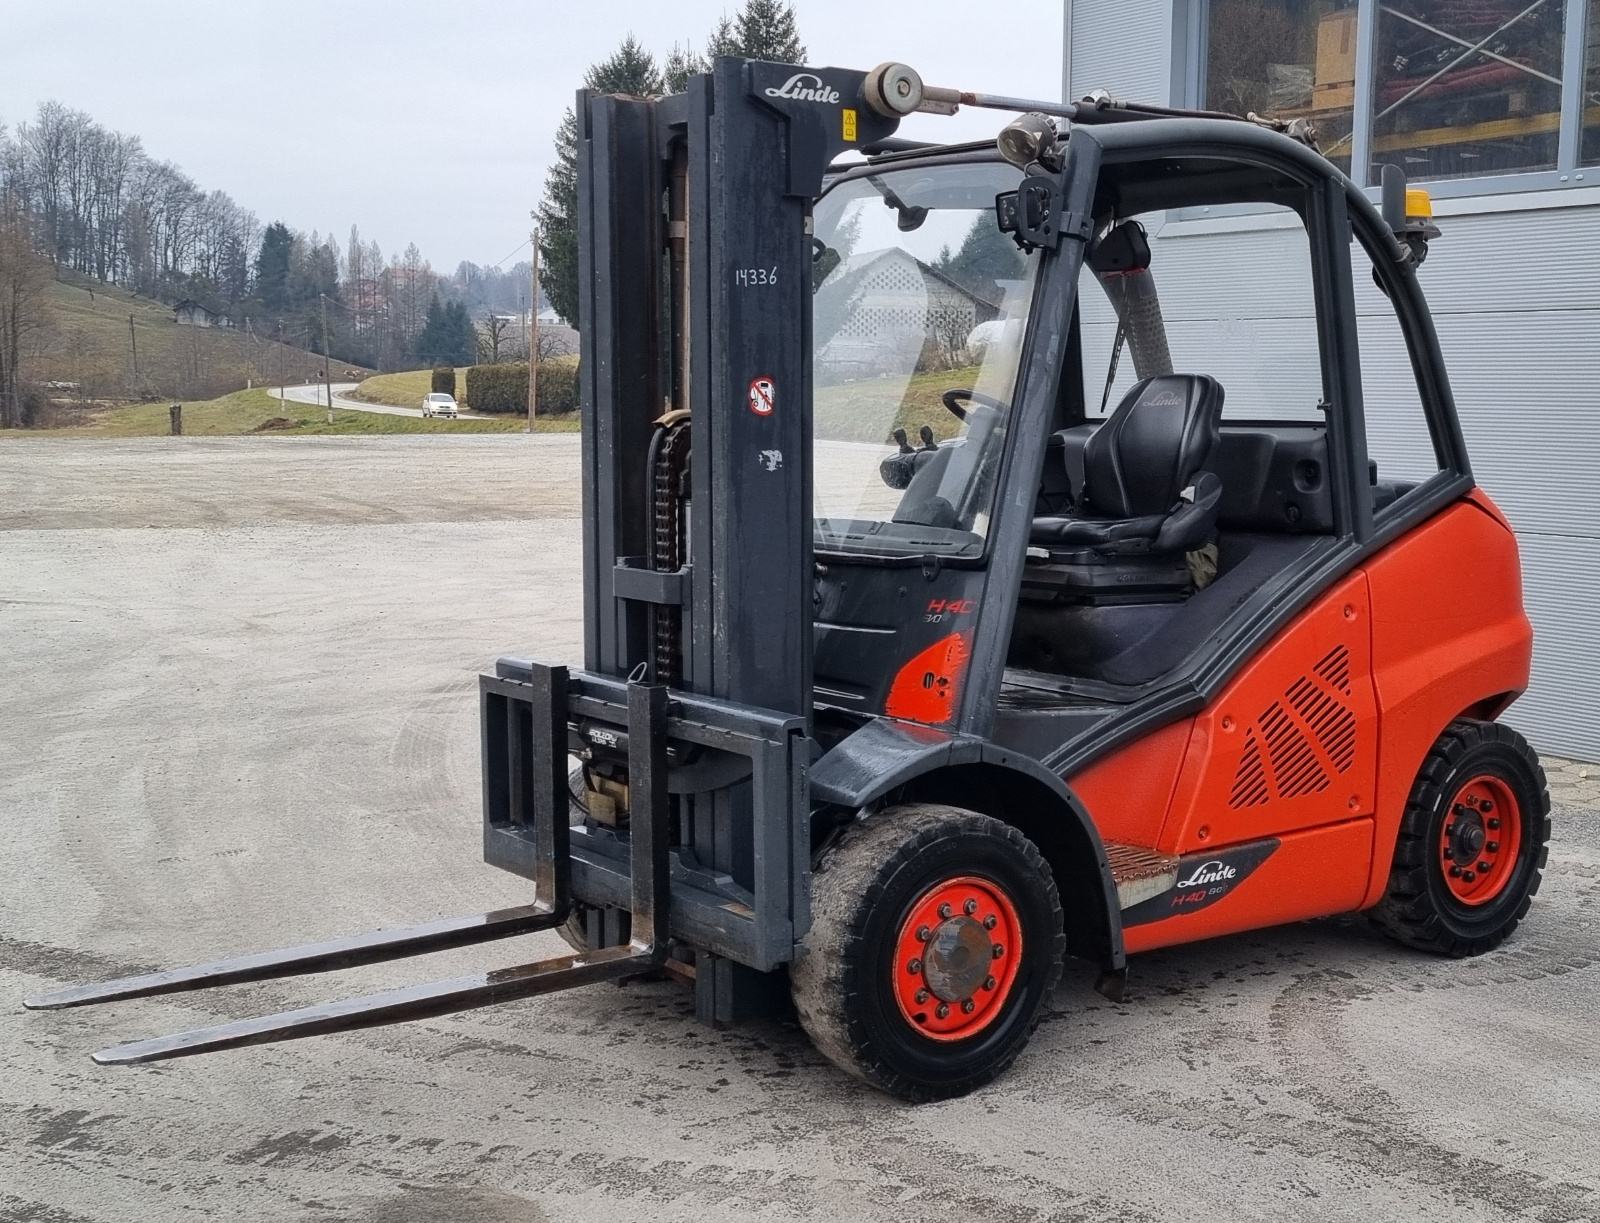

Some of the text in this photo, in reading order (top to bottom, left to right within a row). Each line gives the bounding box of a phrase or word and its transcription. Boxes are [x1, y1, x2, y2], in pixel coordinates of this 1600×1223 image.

[765, 73, 840, 104] Linde
[735, 266, 777, 287] 14336
[1142, 390, 1182, 406] Linde
[1177, 860, 1237, 888] Linde
